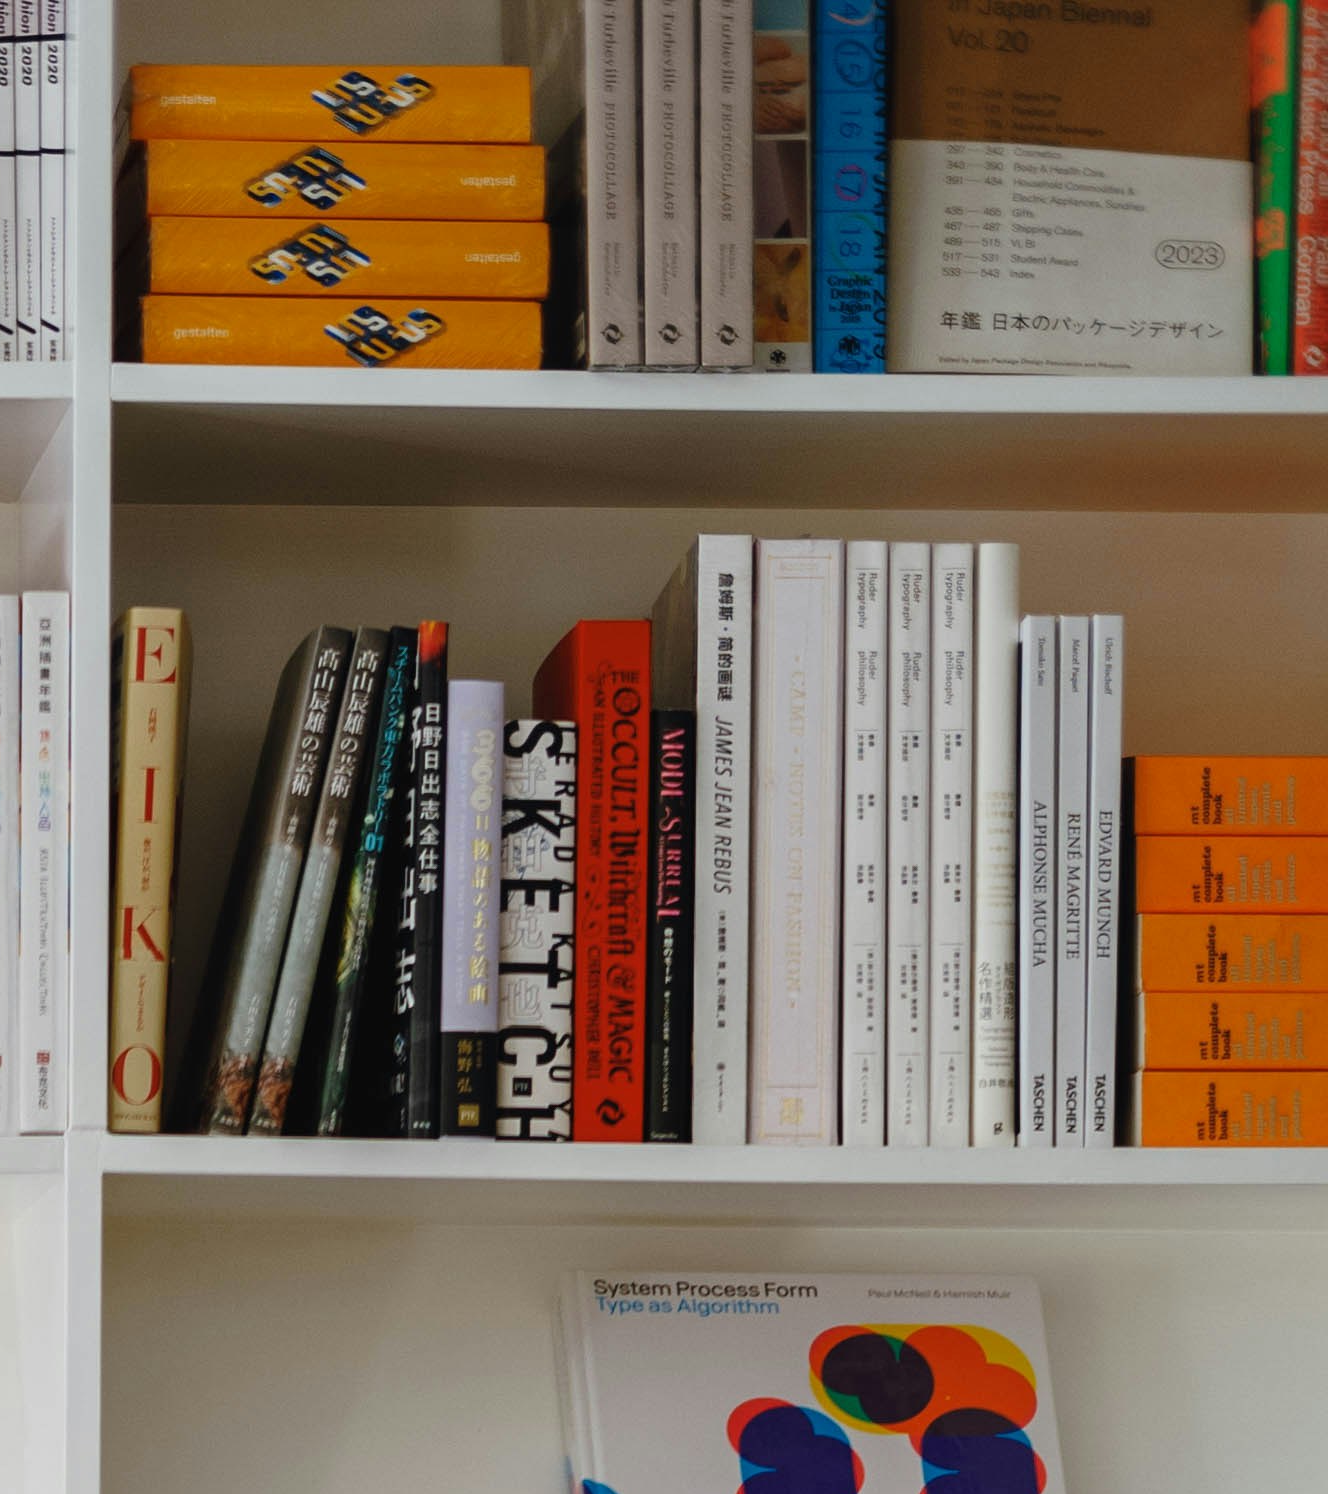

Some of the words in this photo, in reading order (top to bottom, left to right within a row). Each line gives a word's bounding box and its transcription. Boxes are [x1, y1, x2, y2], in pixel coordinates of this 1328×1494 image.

[1162, 243, 1218, 266] 2023
[1032, 801, 1049, 894] ALPHONSE
[1066, 813, 1082, 860] RENÉ
[1098, 809, 1111, 888] EDVARD
[1032, 901, 1048, 966] MUCHA
[1066, 865, 1081, 960] MAGRITTE
[1096, 890, 1110, 959] MUNCH
[594, 1280, 671, 1298] System
[676, 1281, 760, 1298] Process
[764, 1282, 818, 1298] Form
[597, 1299, 644, 1316] Type
[648, 1301, 673, 1314] as
[678, 1299, 778, 1317] Algorithm
